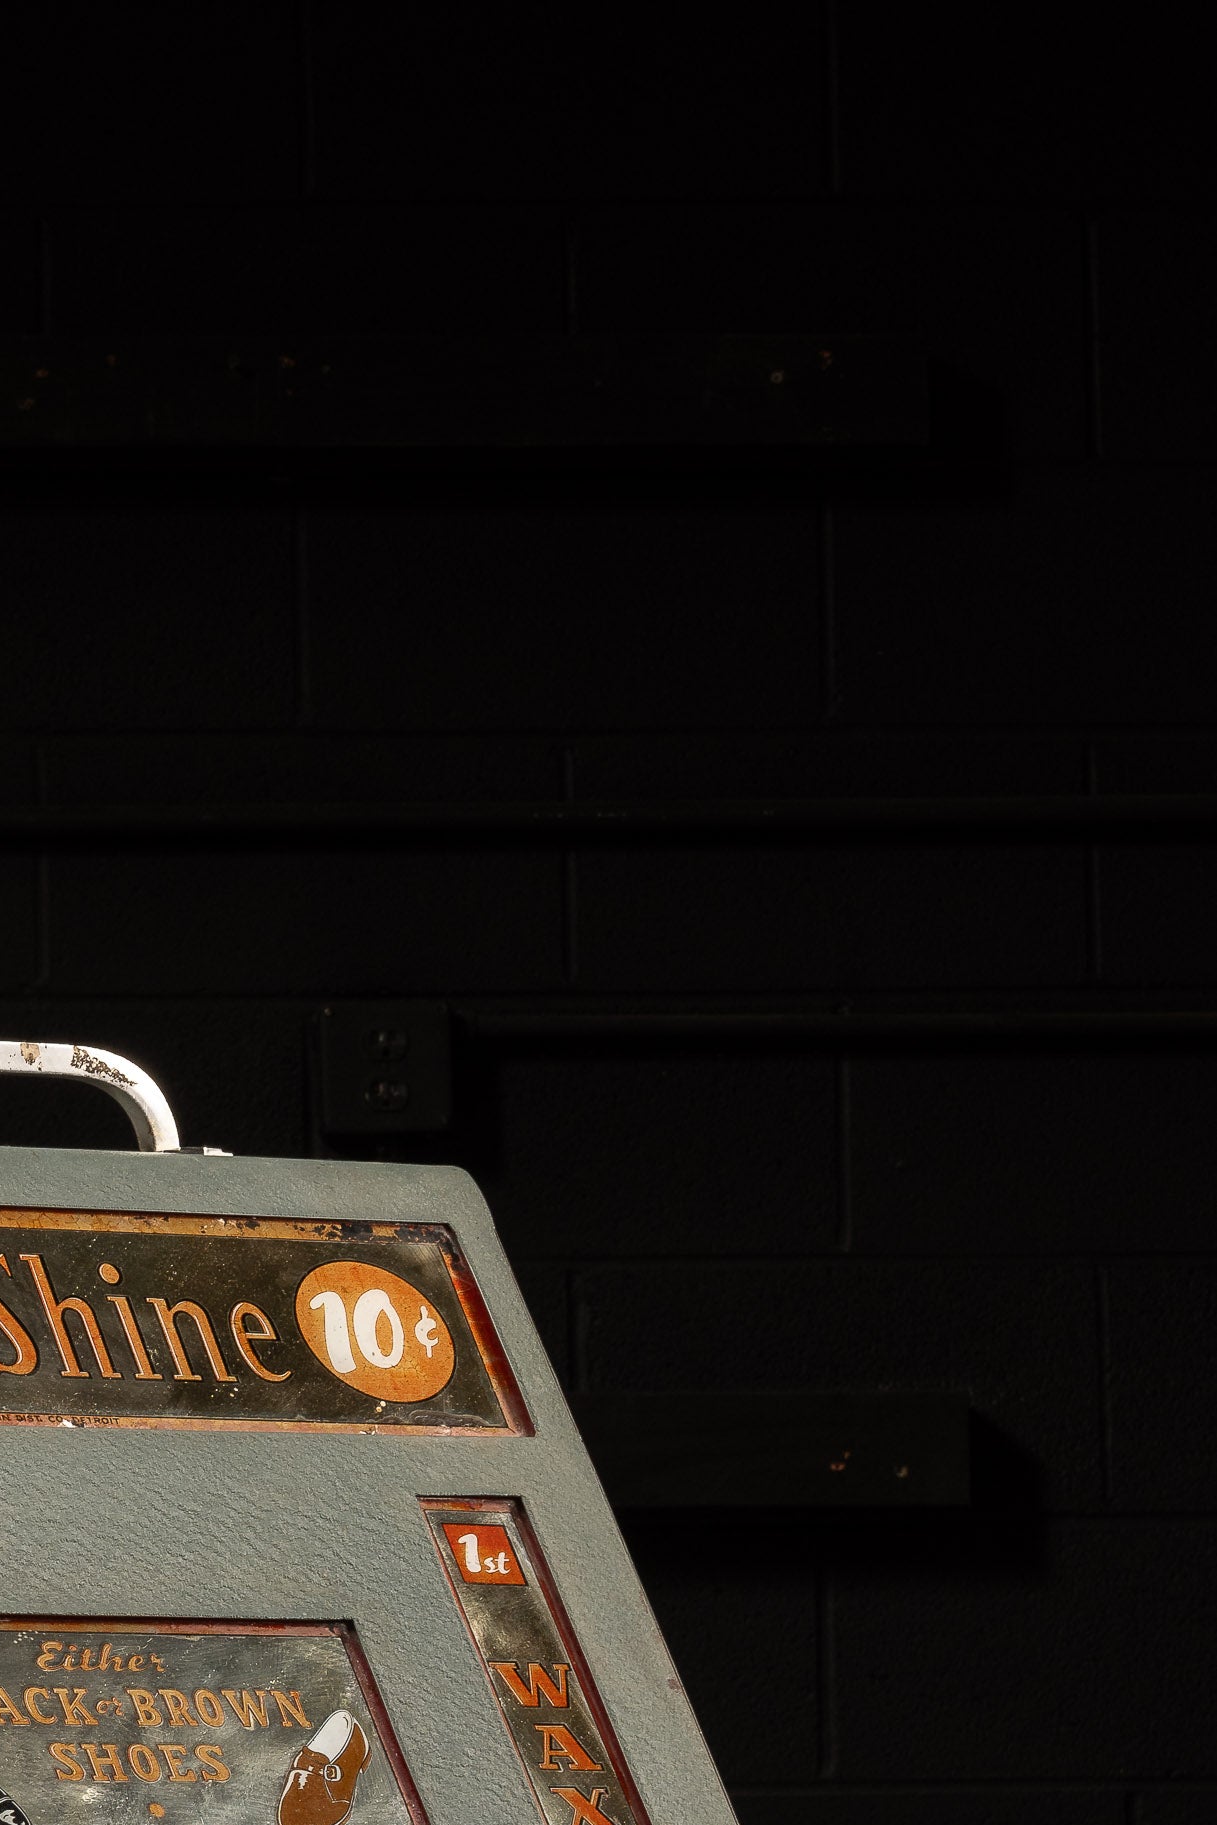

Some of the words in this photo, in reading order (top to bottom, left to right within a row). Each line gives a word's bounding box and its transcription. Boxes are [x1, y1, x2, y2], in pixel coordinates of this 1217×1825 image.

[308, 1288, 440, 1374] 10¢
[458, 1533, 511, 1575] 1st
[36, 1641, 166, 1674] Either
[95, 1697, 126, 1717] or
[127, 1688, 314, 1730] BROWN
[49, 1743, 232, 1784] SHOES
